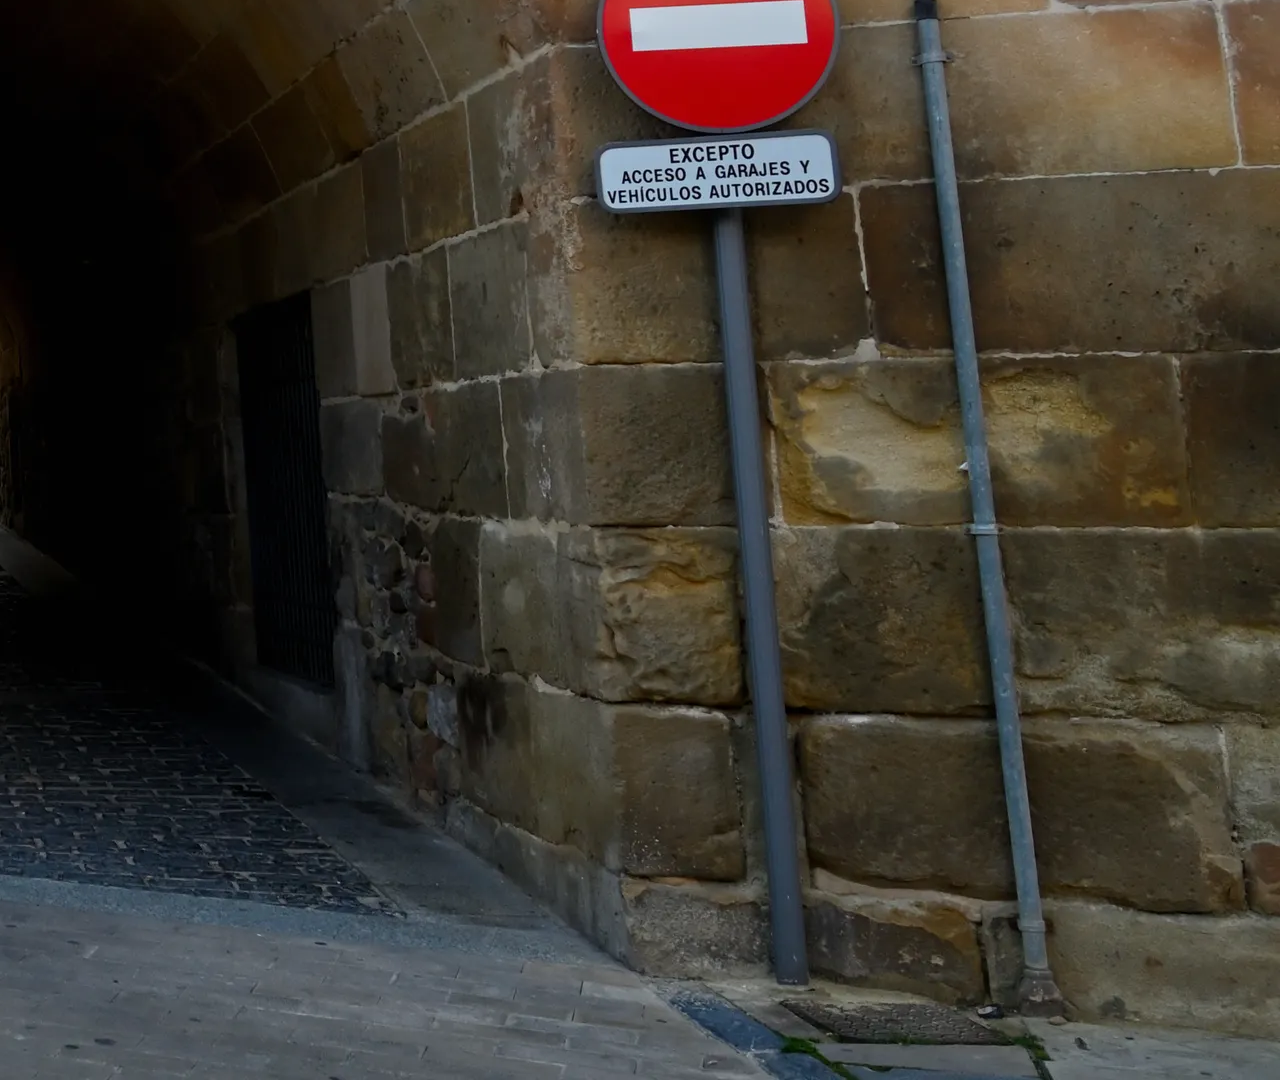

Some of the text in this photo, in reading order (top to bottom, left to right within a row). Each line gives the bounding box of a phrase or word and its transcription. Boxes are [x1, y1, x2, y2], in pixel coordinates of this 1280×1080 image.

[668, 143, 755, 164] EXCEPTO
[621, 159, 810, 185] ACCESO A GARAJES Y
[607, 178, 830, 204] VEHÍCULOS AUTORIZADOS
